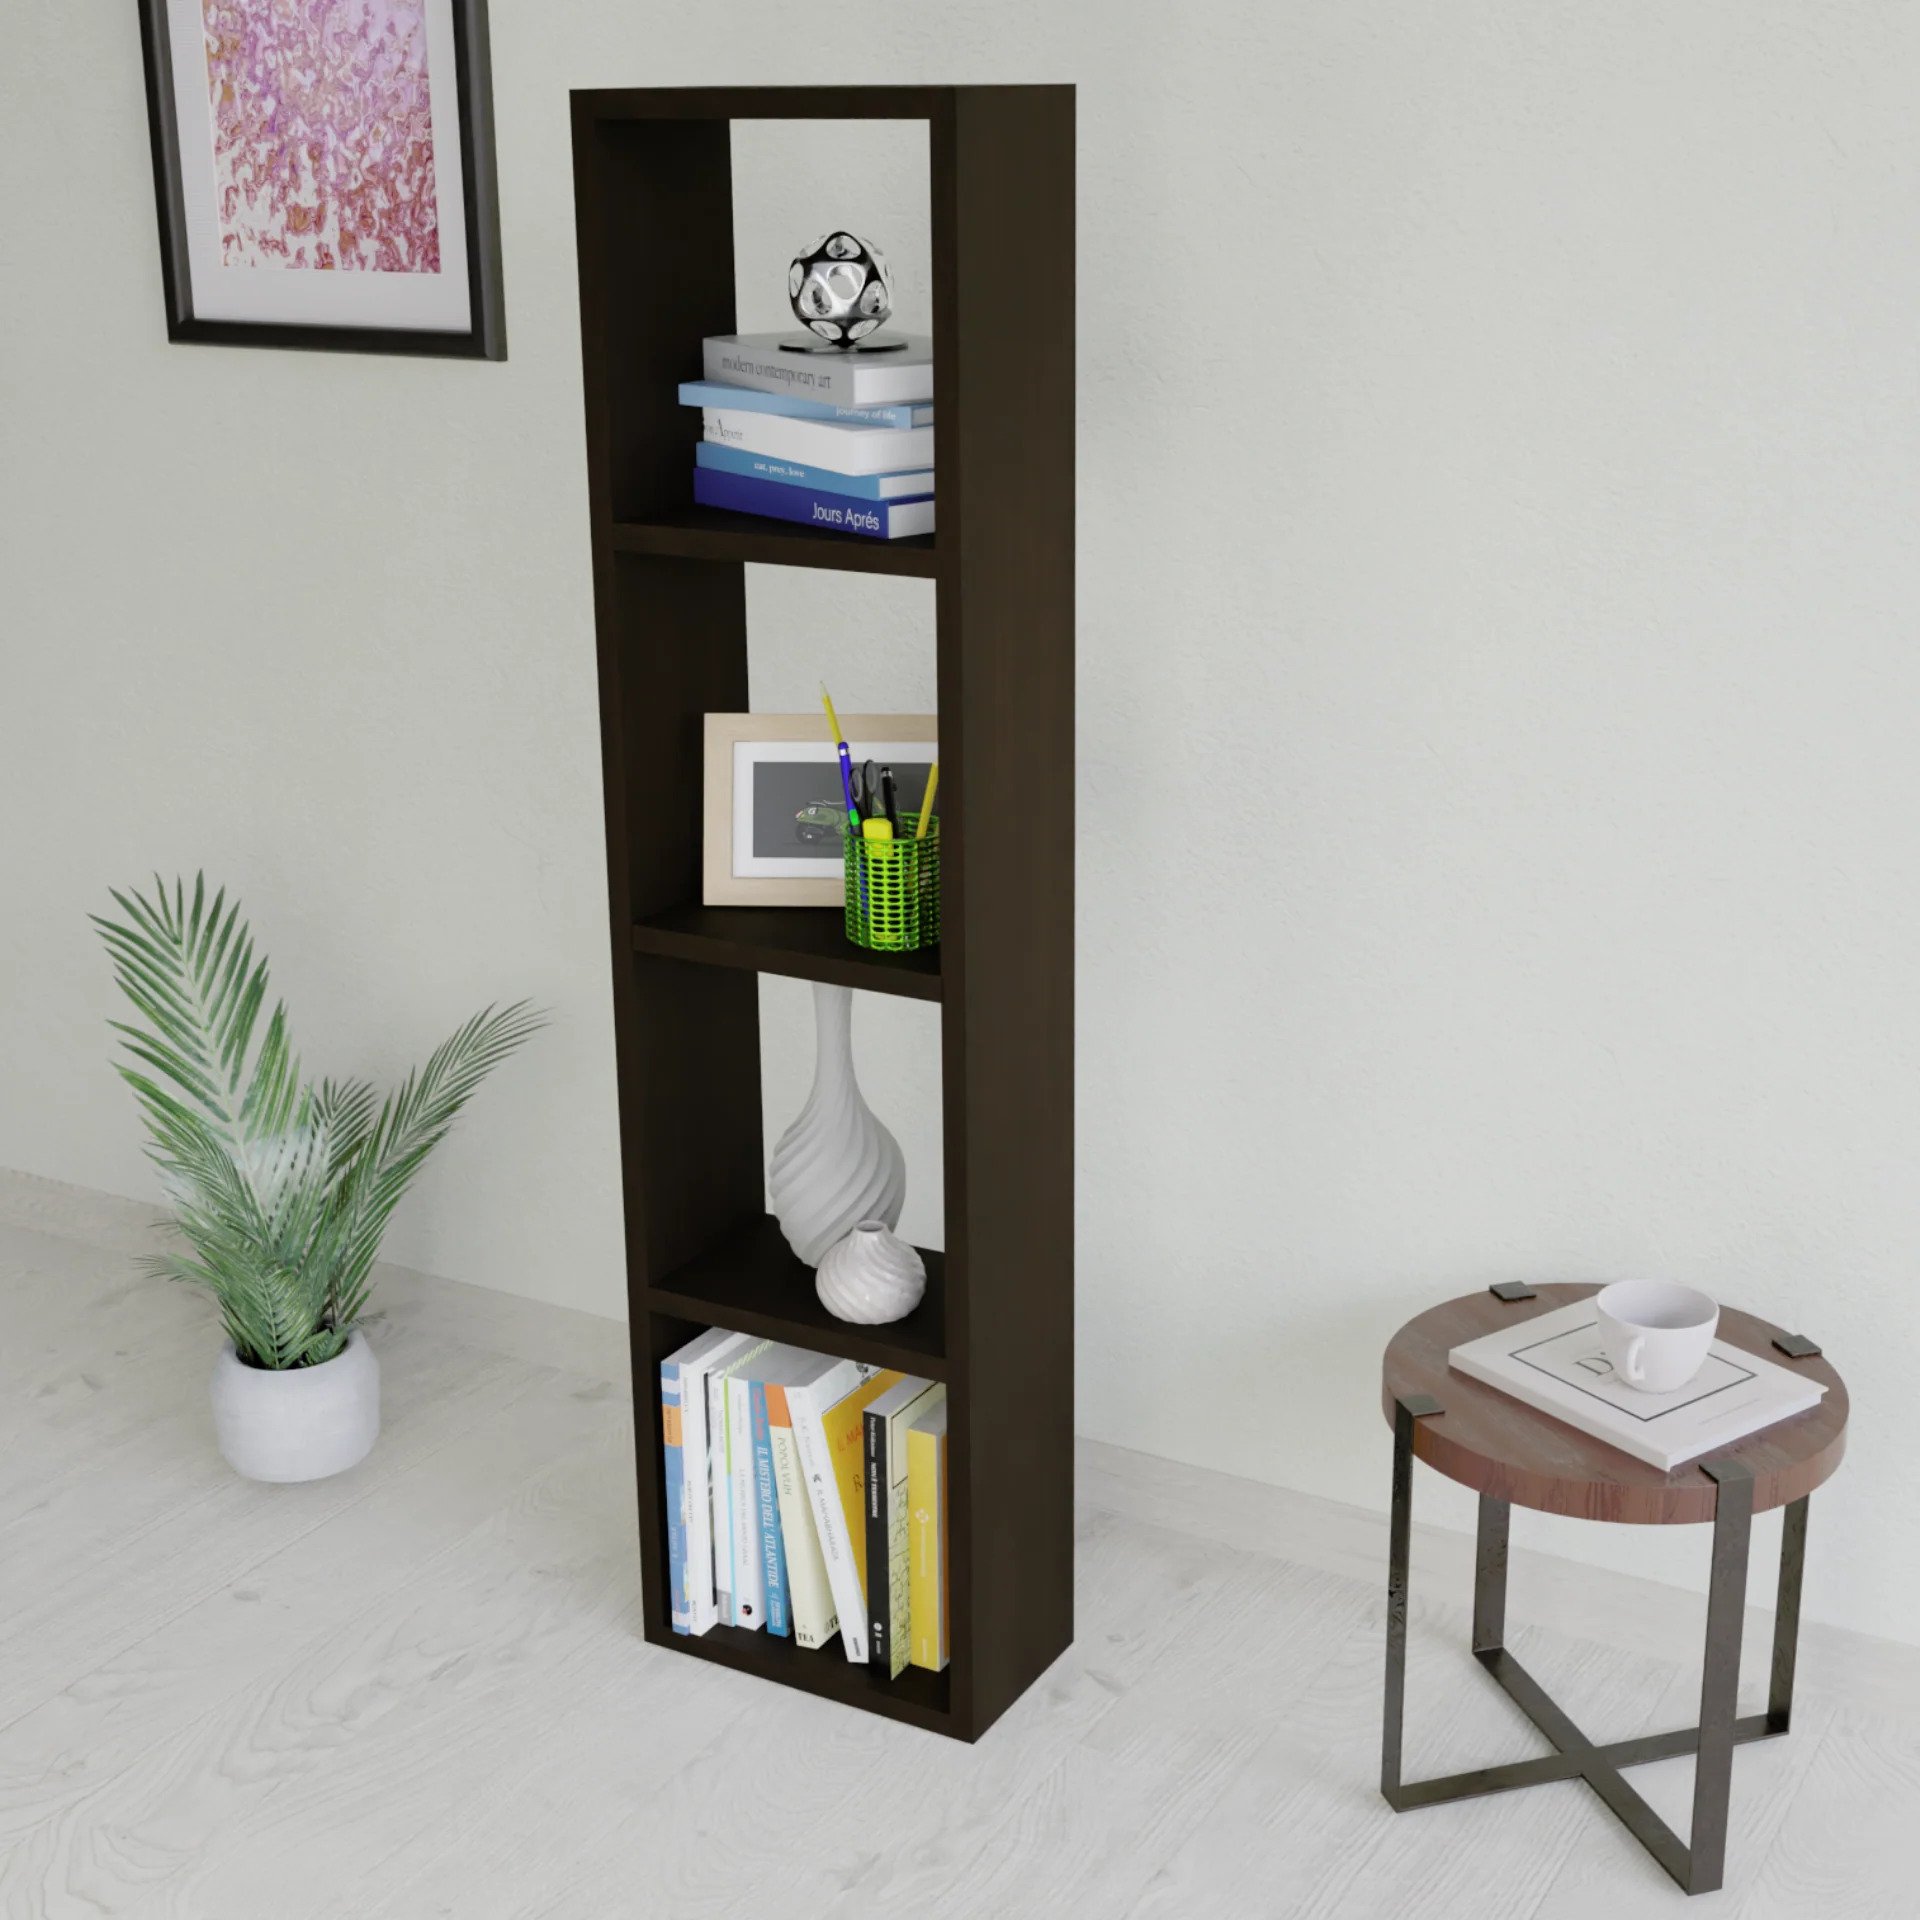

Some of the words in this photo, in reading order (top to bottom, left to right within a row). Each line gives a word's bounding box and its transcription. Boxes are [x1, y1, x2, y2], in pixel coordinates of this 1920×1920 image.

[722, 355, 754, 374] modern
[755, 365, 817, 389] contemporary
[818, 375, 832, 389] art
[883, 409, 897, 420] life
[812, 501, 843, 524] Jours
[845, 507, 880, 531] Aprés
[757, 1446, 769, 1456] IL
[778, 1437, 789, 1470] POPOL
[758, 1459, 772, 1502] MISTERO
[782, 1472, 793, 1496] VUH
[764, 1532, 780, 1589] ATLANTIDE
[797, 1632, 815, 1643] TEA
